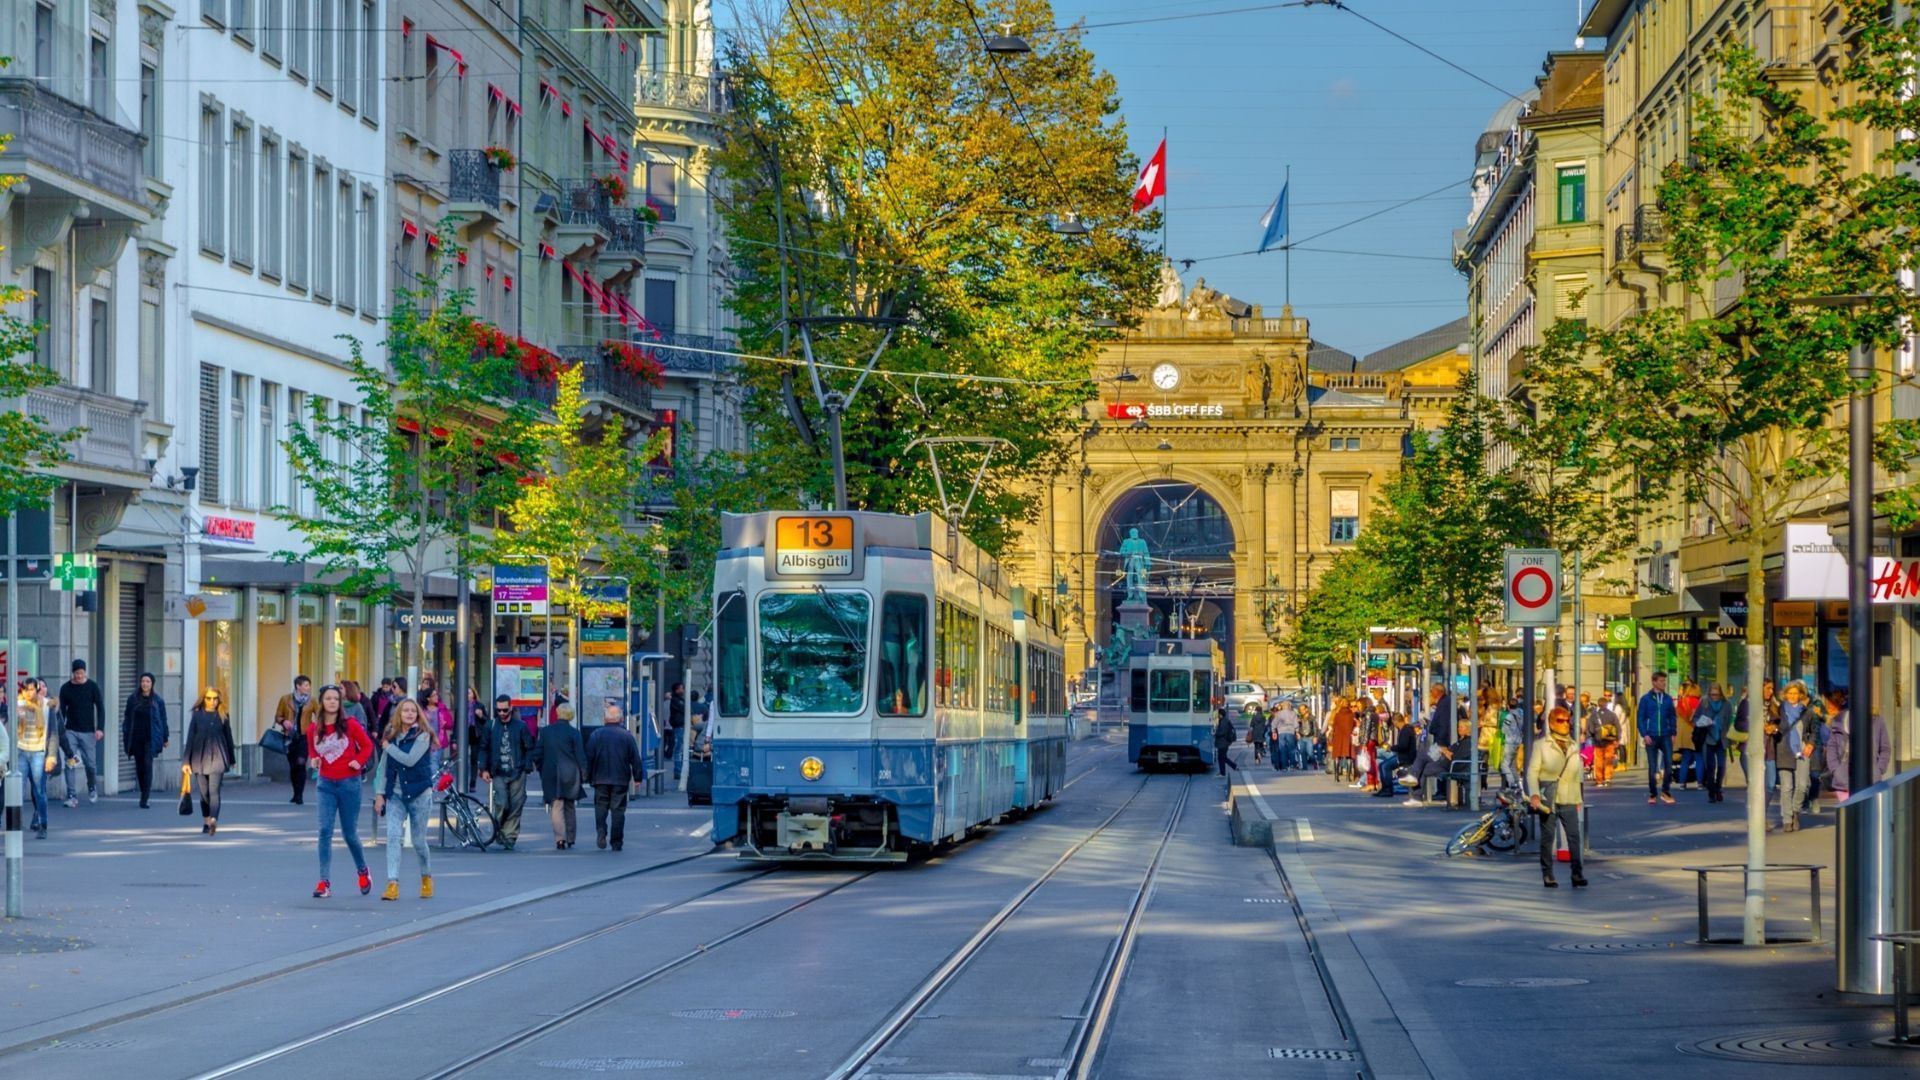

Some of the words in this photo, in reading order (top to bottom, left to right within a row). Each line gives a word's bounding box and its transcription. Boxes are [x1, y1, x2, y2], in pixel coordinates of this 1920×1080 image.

[1147, 404, 1171, 416] SBB
[1174, 404, 1198, 416] CFF
[1200, 404, 1223, 416] FFS
[796, 520, 834, 548] 13
[781, 554, 848, 570] Albisgütli
[1521, 557, 1545, 566] ZONE
[498, 591, 507, 600] 17
[1723, 606, 1749, 614] TISSO
[401, 614, 456, 625] GODHAUS
[1656, 630, 1689, 641] GÖTTE
[1166, 642, 1176, 655] 7
